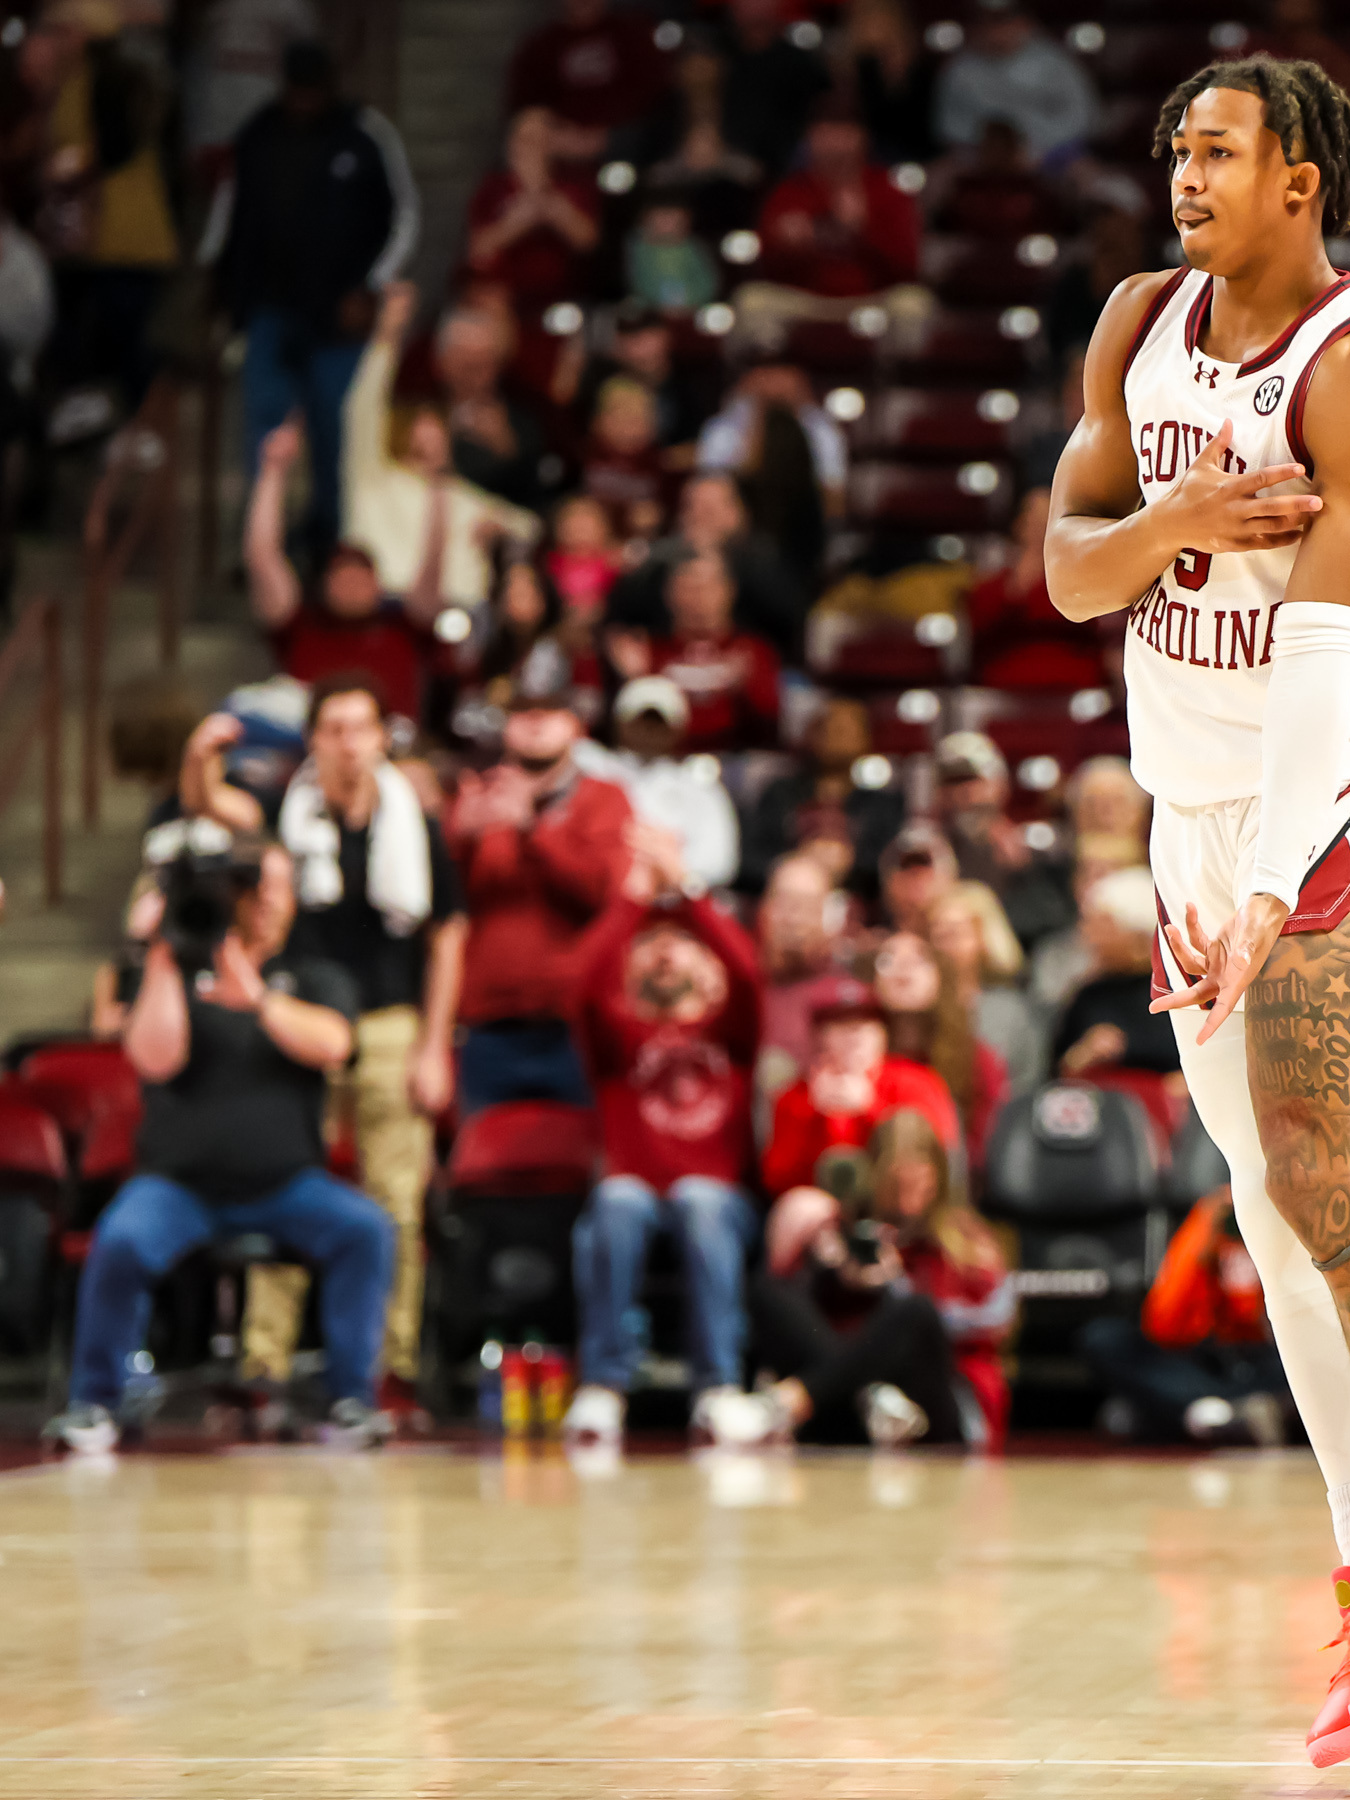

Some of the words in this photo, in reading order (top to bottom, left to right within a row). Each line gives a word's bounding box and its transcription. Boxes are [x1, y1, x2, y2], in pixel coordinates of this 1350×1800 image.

[1255, 377, 1282, 413] SEC
[1140, 420, 1247, 485] SOU
[1130, 577, 1283, 670] AROLIN
